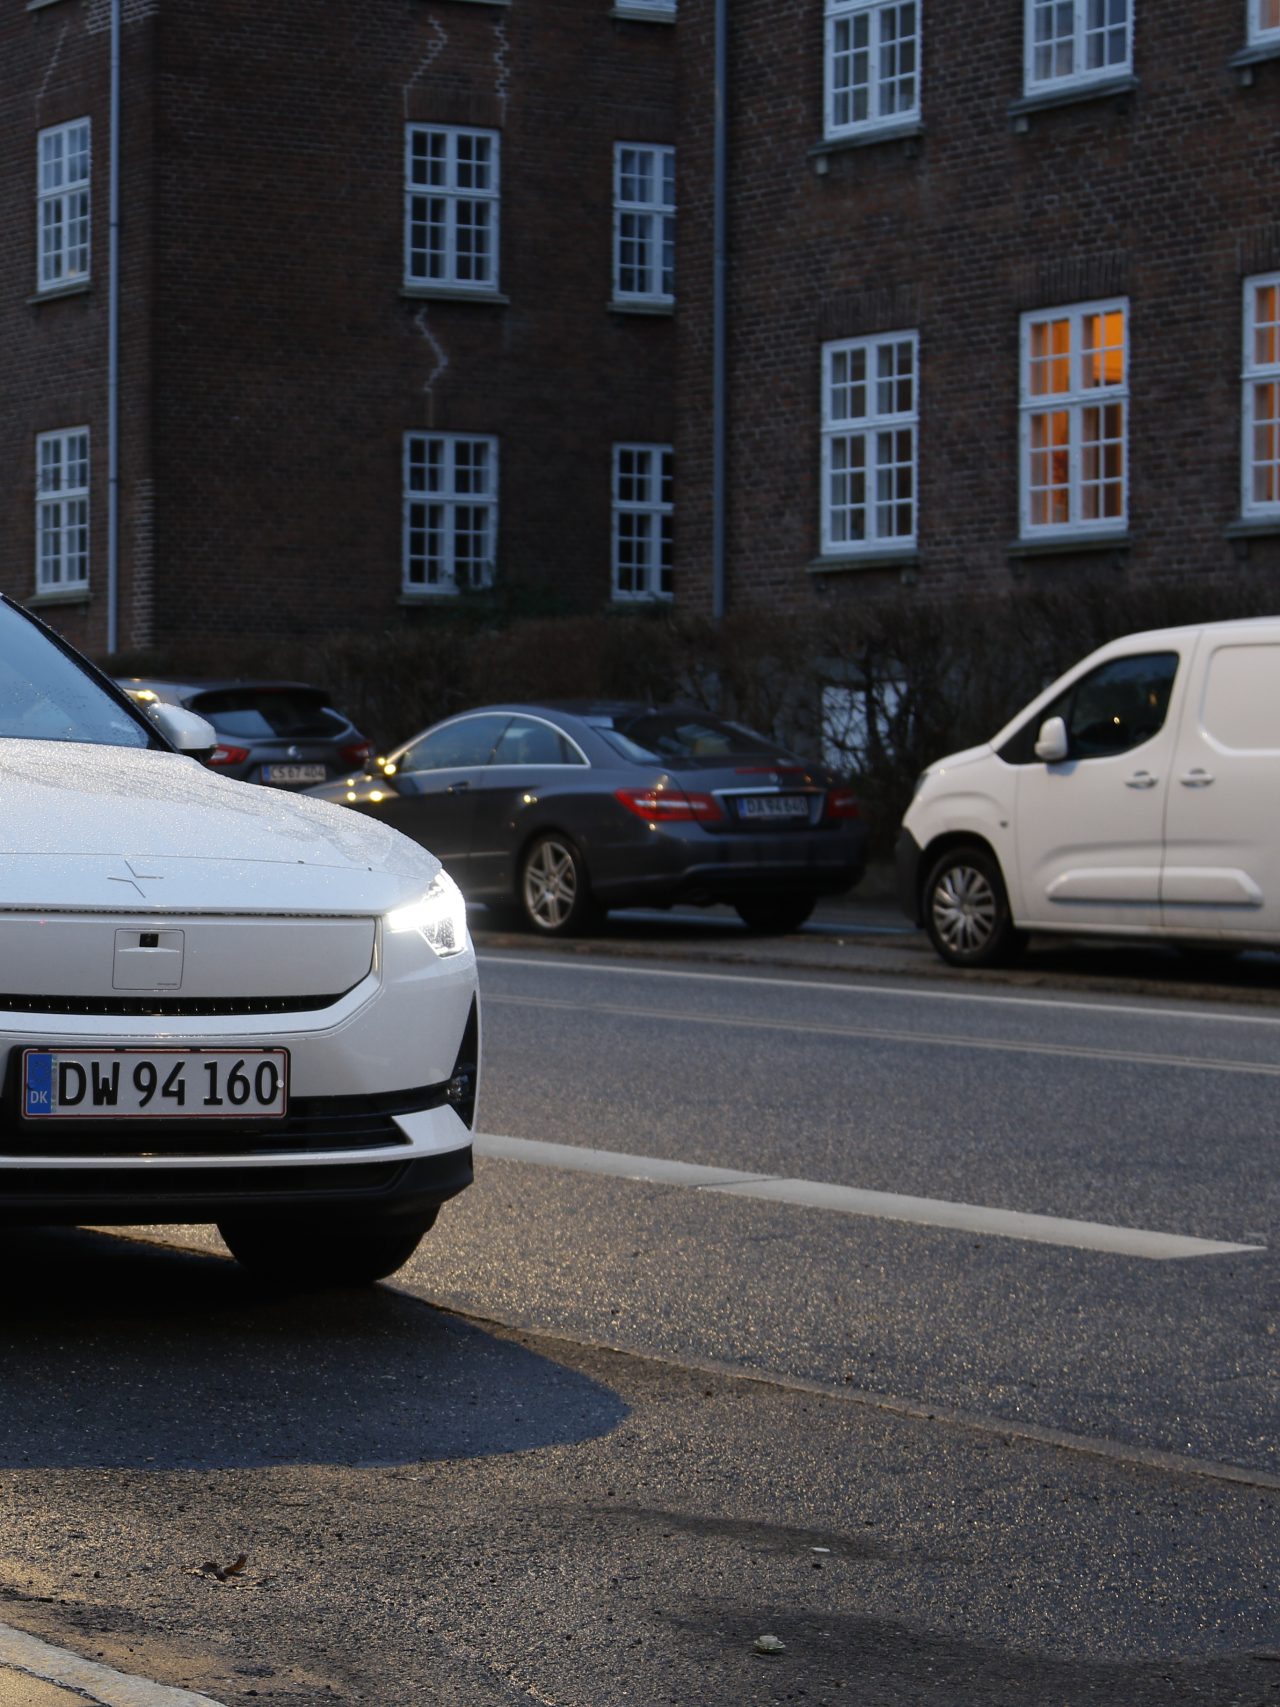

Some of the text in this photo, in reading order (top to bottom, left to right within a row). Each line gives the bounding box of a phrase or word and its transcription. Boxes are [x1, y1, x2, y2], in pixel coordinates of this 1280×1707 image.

[271, 765, 286, 778] CS
[58, 1059, 279, 1107] DW 94 160
[30, 1090, 48, 1104] DK
